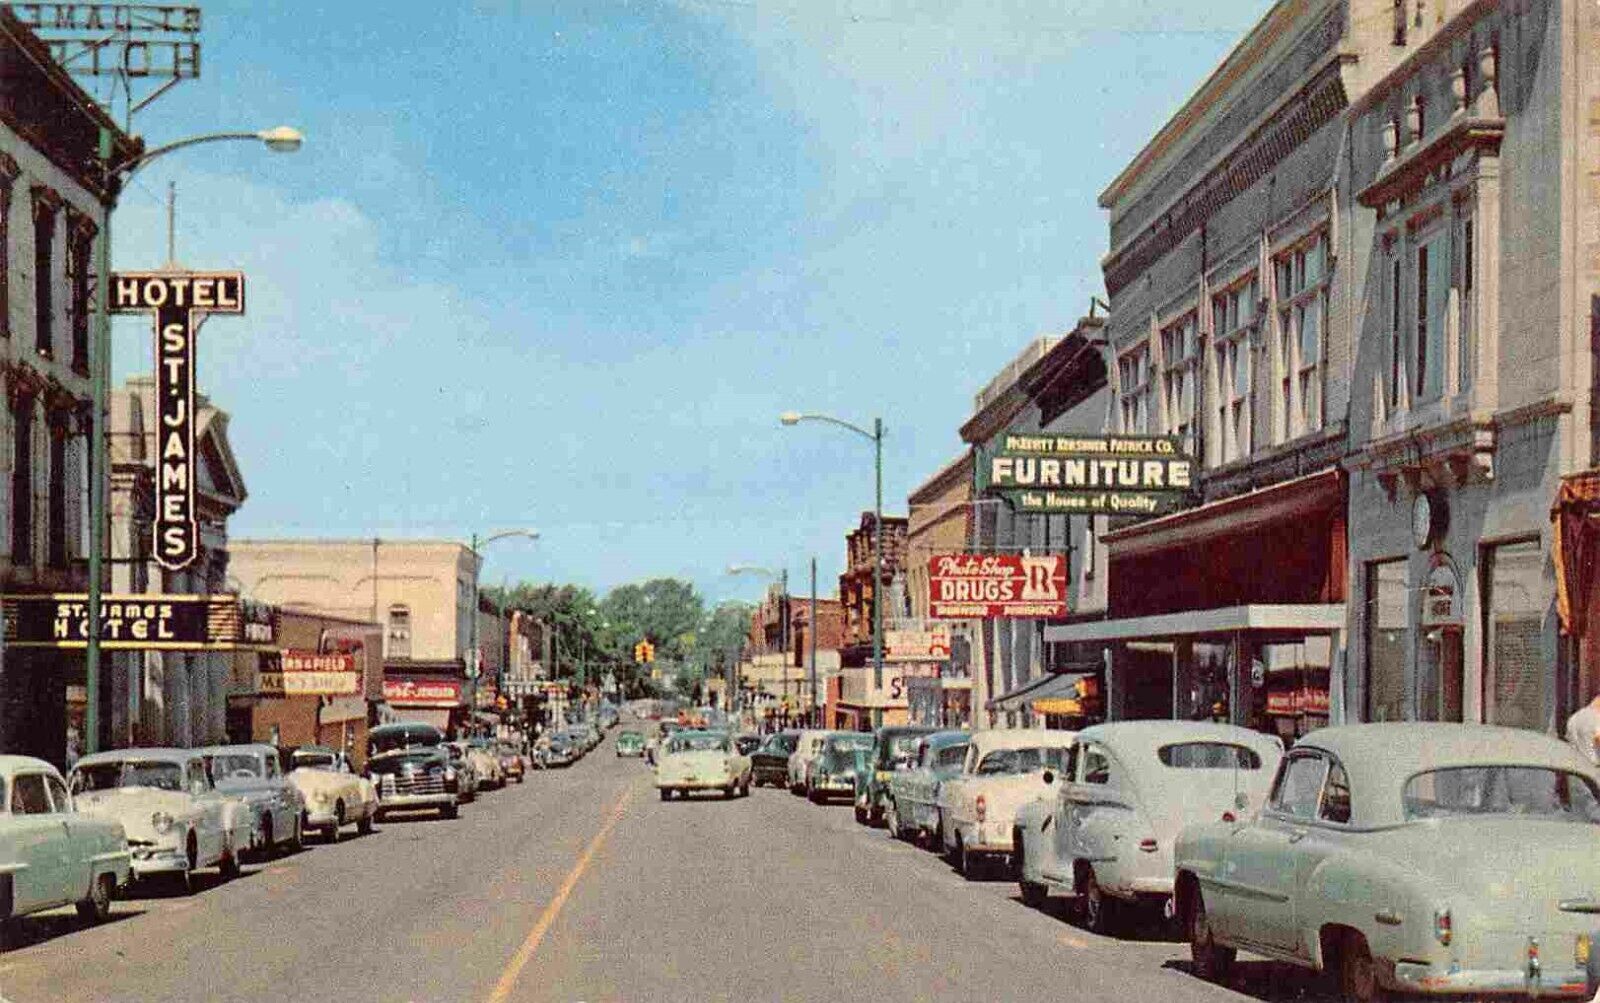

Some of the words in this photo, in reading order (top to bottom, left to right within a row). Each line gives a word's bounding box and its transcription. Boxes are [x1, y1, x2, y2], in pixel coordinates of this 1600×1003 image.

[116, 278, 237, 306] HOTEL
[162, 399, 187, 554] JAMES
[991, 457, 1191, 488] FURNITURE
[1021, 491, 1043, 507] the
[1046, 492, 1087, 508] House
[1091, 493, 1106, 507] of
[1110, 494, 1158, 512] Quality
[941, 580, 1014, 601] DRUGS
[57, 603, 88, 618] ST.
[54, 618, 174, 639] HOTEL
